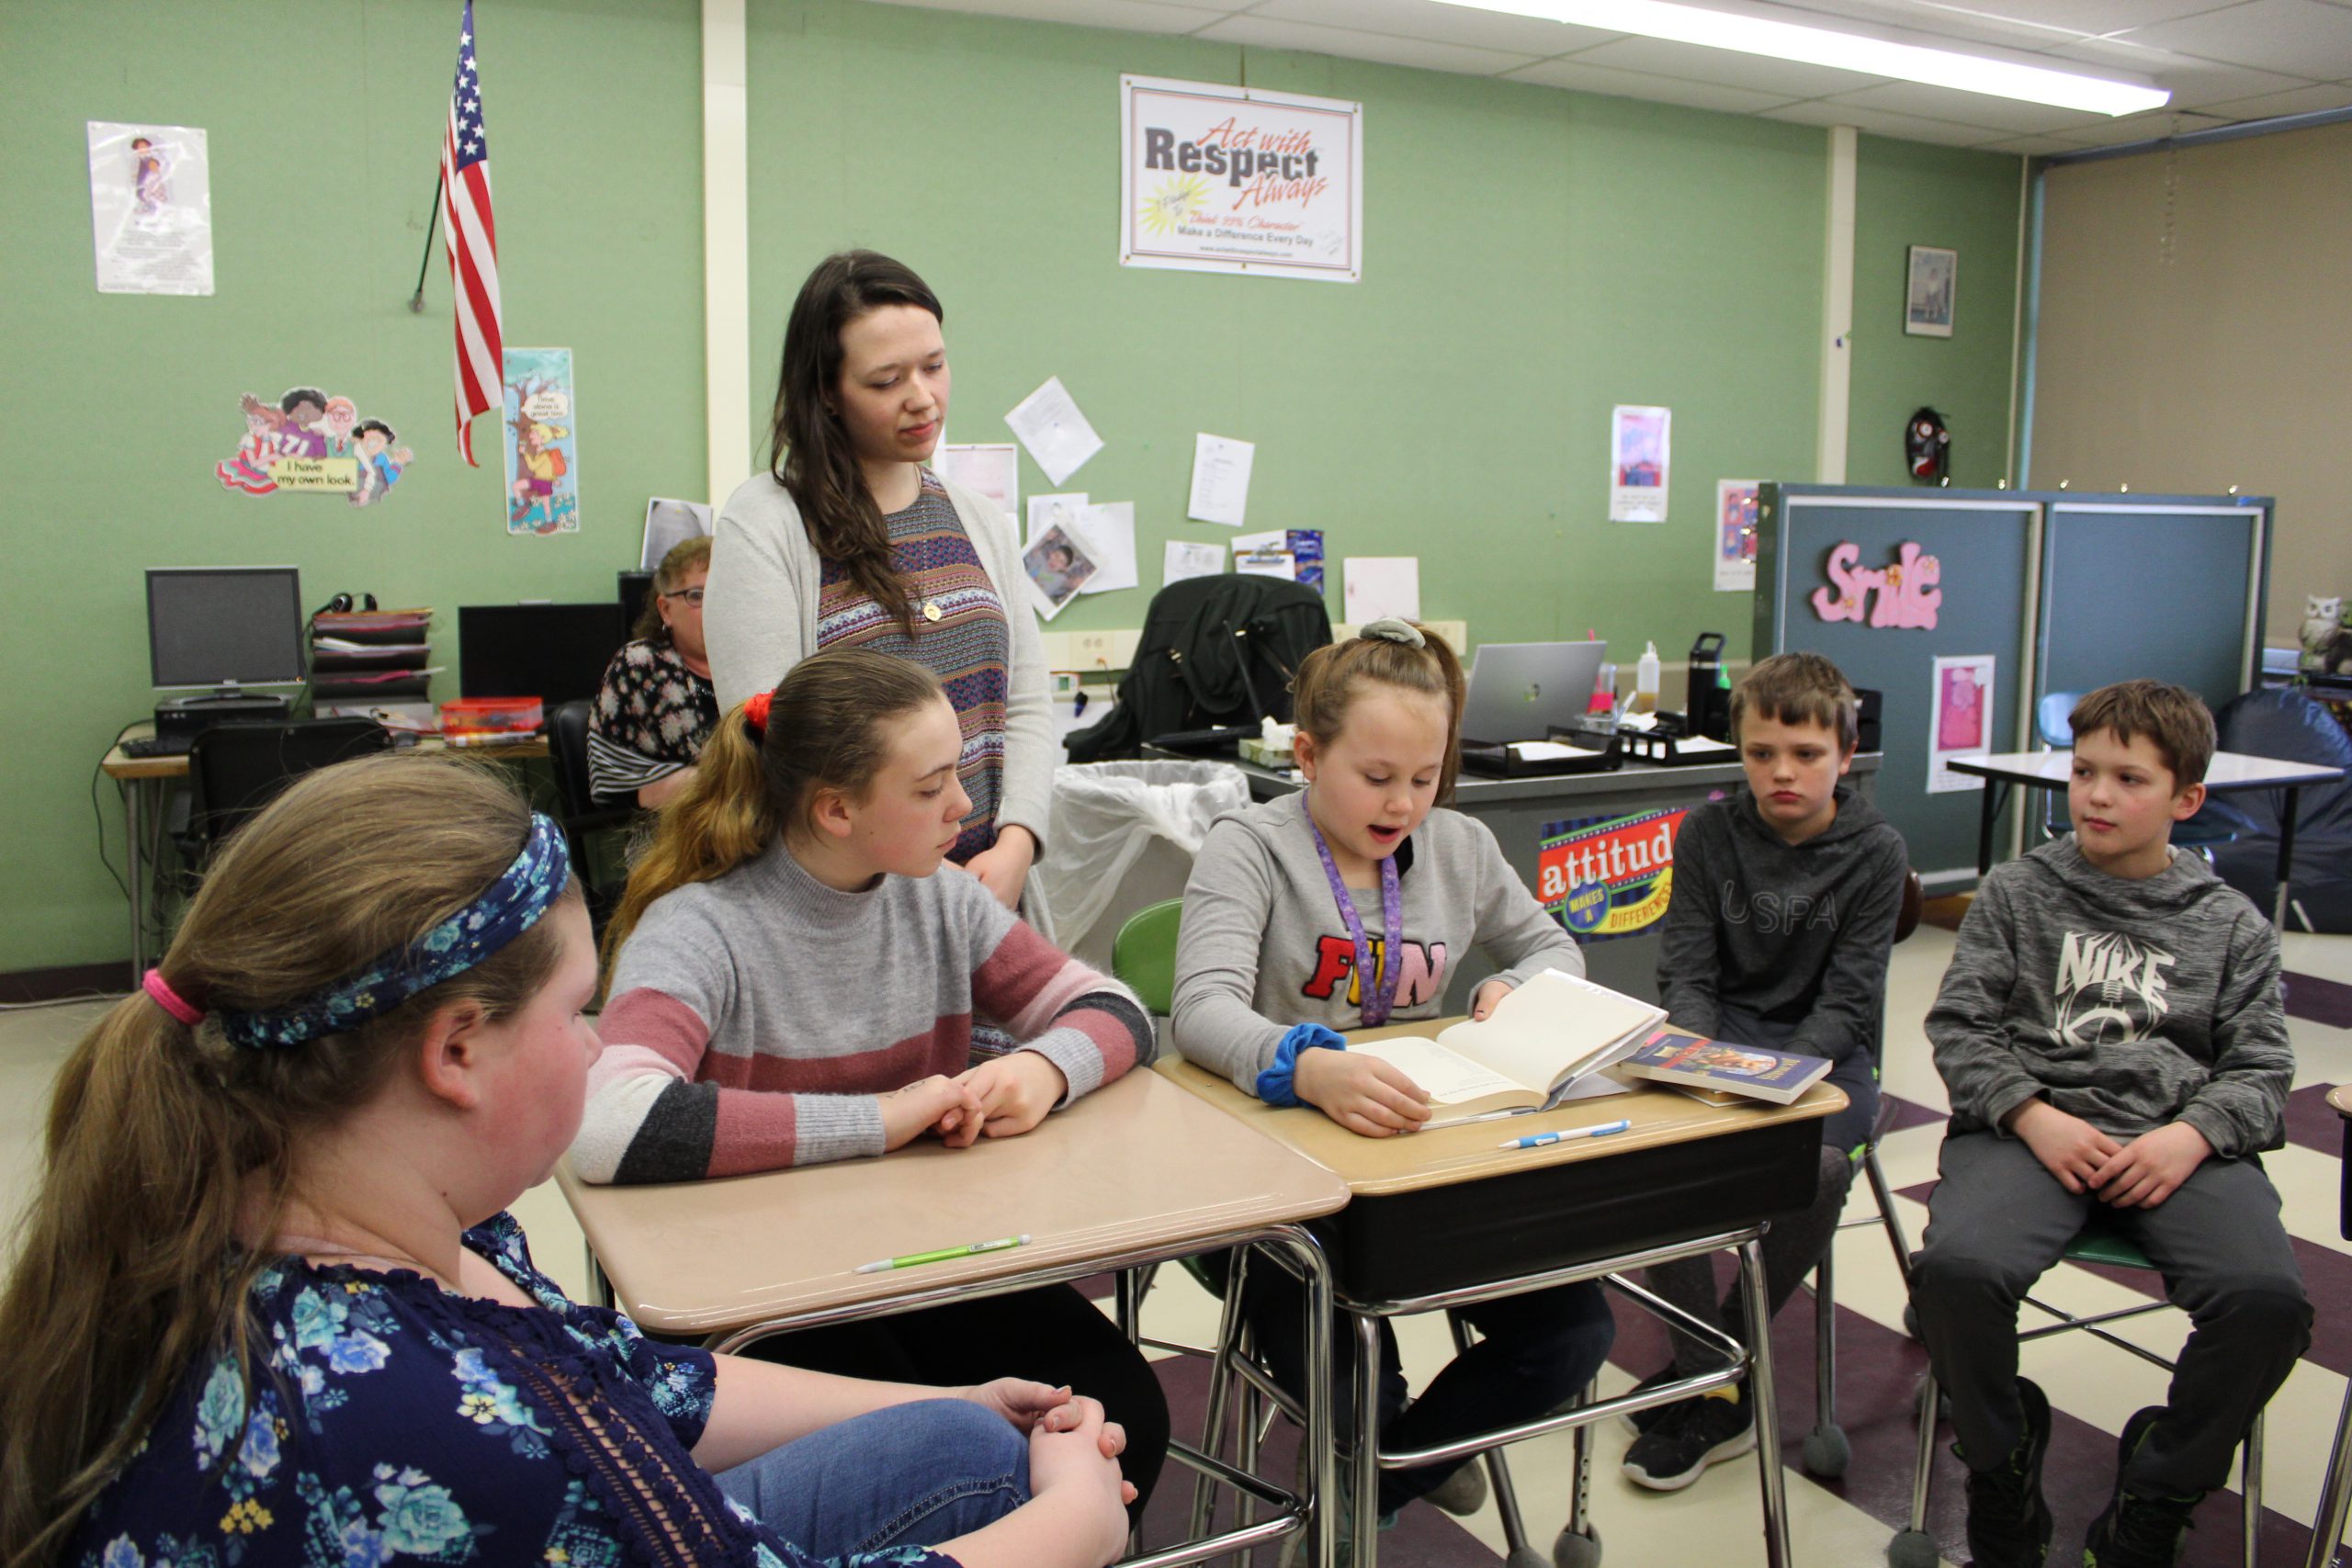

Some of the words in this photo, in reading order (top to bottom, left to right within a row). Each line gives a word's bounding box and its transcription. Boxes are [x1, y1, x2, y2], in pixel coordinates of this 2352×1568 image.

[1196, 117, 1258, 147] Act
[1257, 128, 1311, 156] with
[1145, 126, 1318, 187] Respect
[1232, 172, 1329, 211] Always
[1177, 225, 1204, 238] Make
[1214, 227, 1264, 243] Difference
[1266, 231, 1295, 246] Every
[1295, 234, 1315, 248] Day
[277, 475, 297, 486] my
[297, 477, 324, 485] own
[326, 473, 356, 486] look.
[287, 461, 291, 472] I
[293, 461, 323, 472] have
[1812, 540, 1943, 631] Smile
[1543, 822, 1674, 897] attitud
[1568, 887, 1605, 914] MAKES
[1585, 908, 1594, 923] A
[1720, 879, 1838, 936] USPA
[1302, 934, 1448, 1010] FUN
[2054, 931, 2177, 1014] NIKE
